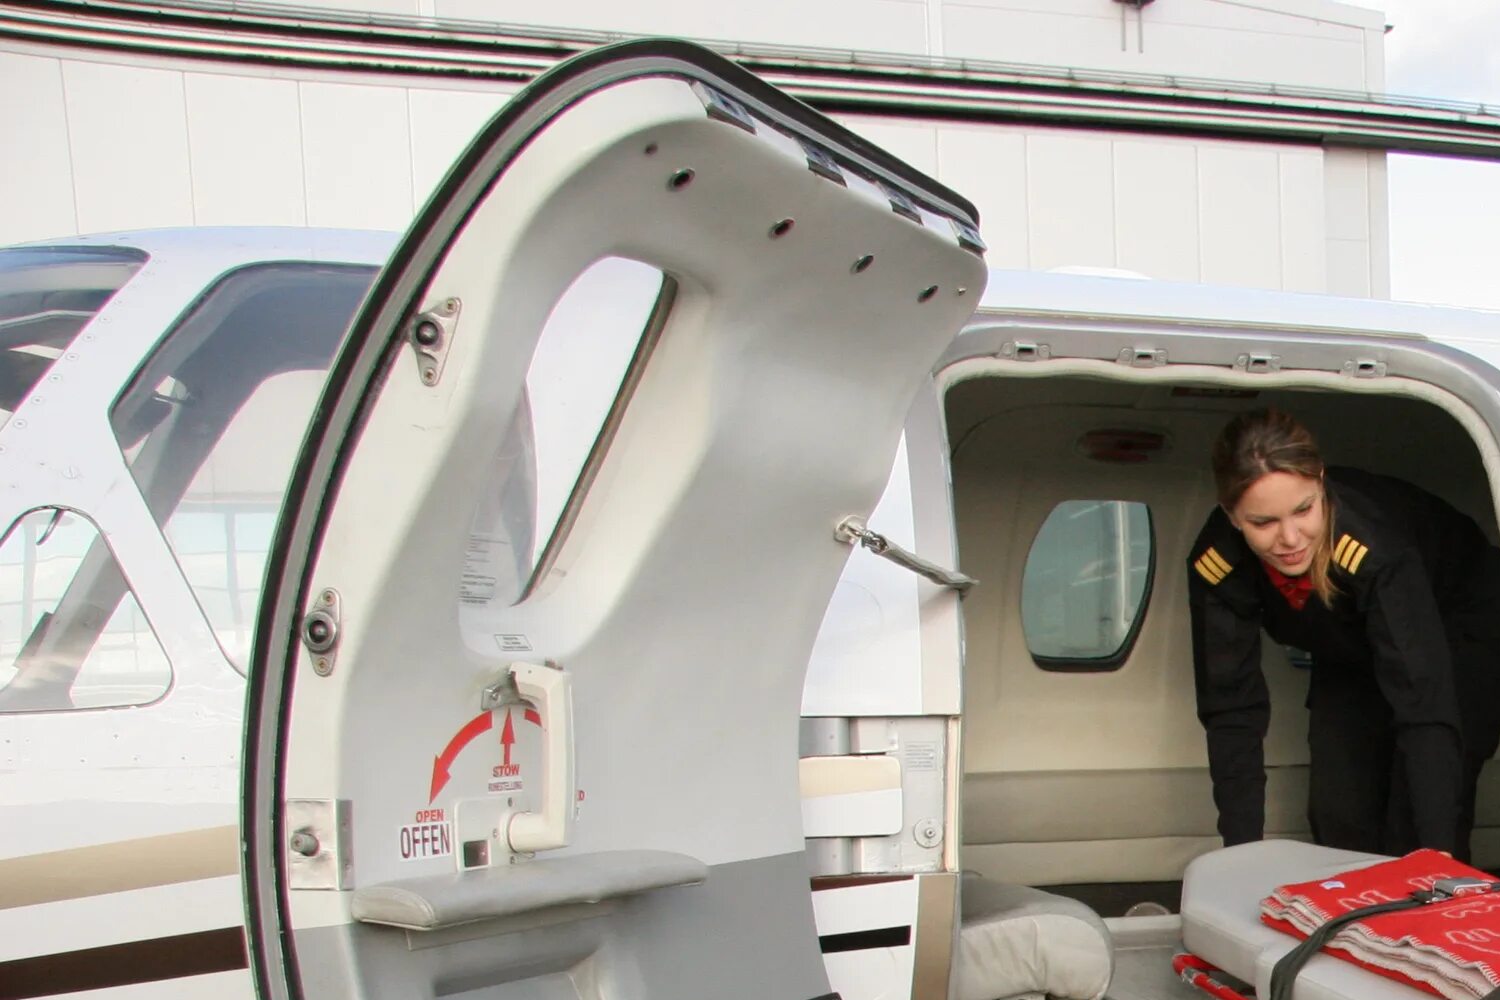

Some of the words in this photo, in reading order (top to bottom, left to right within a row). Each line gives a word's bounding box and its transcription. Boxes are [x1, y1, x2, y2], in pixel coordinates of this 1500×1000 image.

[493, 764, 520, 777] STOW
[416, 809, 444, 823] OPEN
[400, 824, 450, 859] OFFEN
